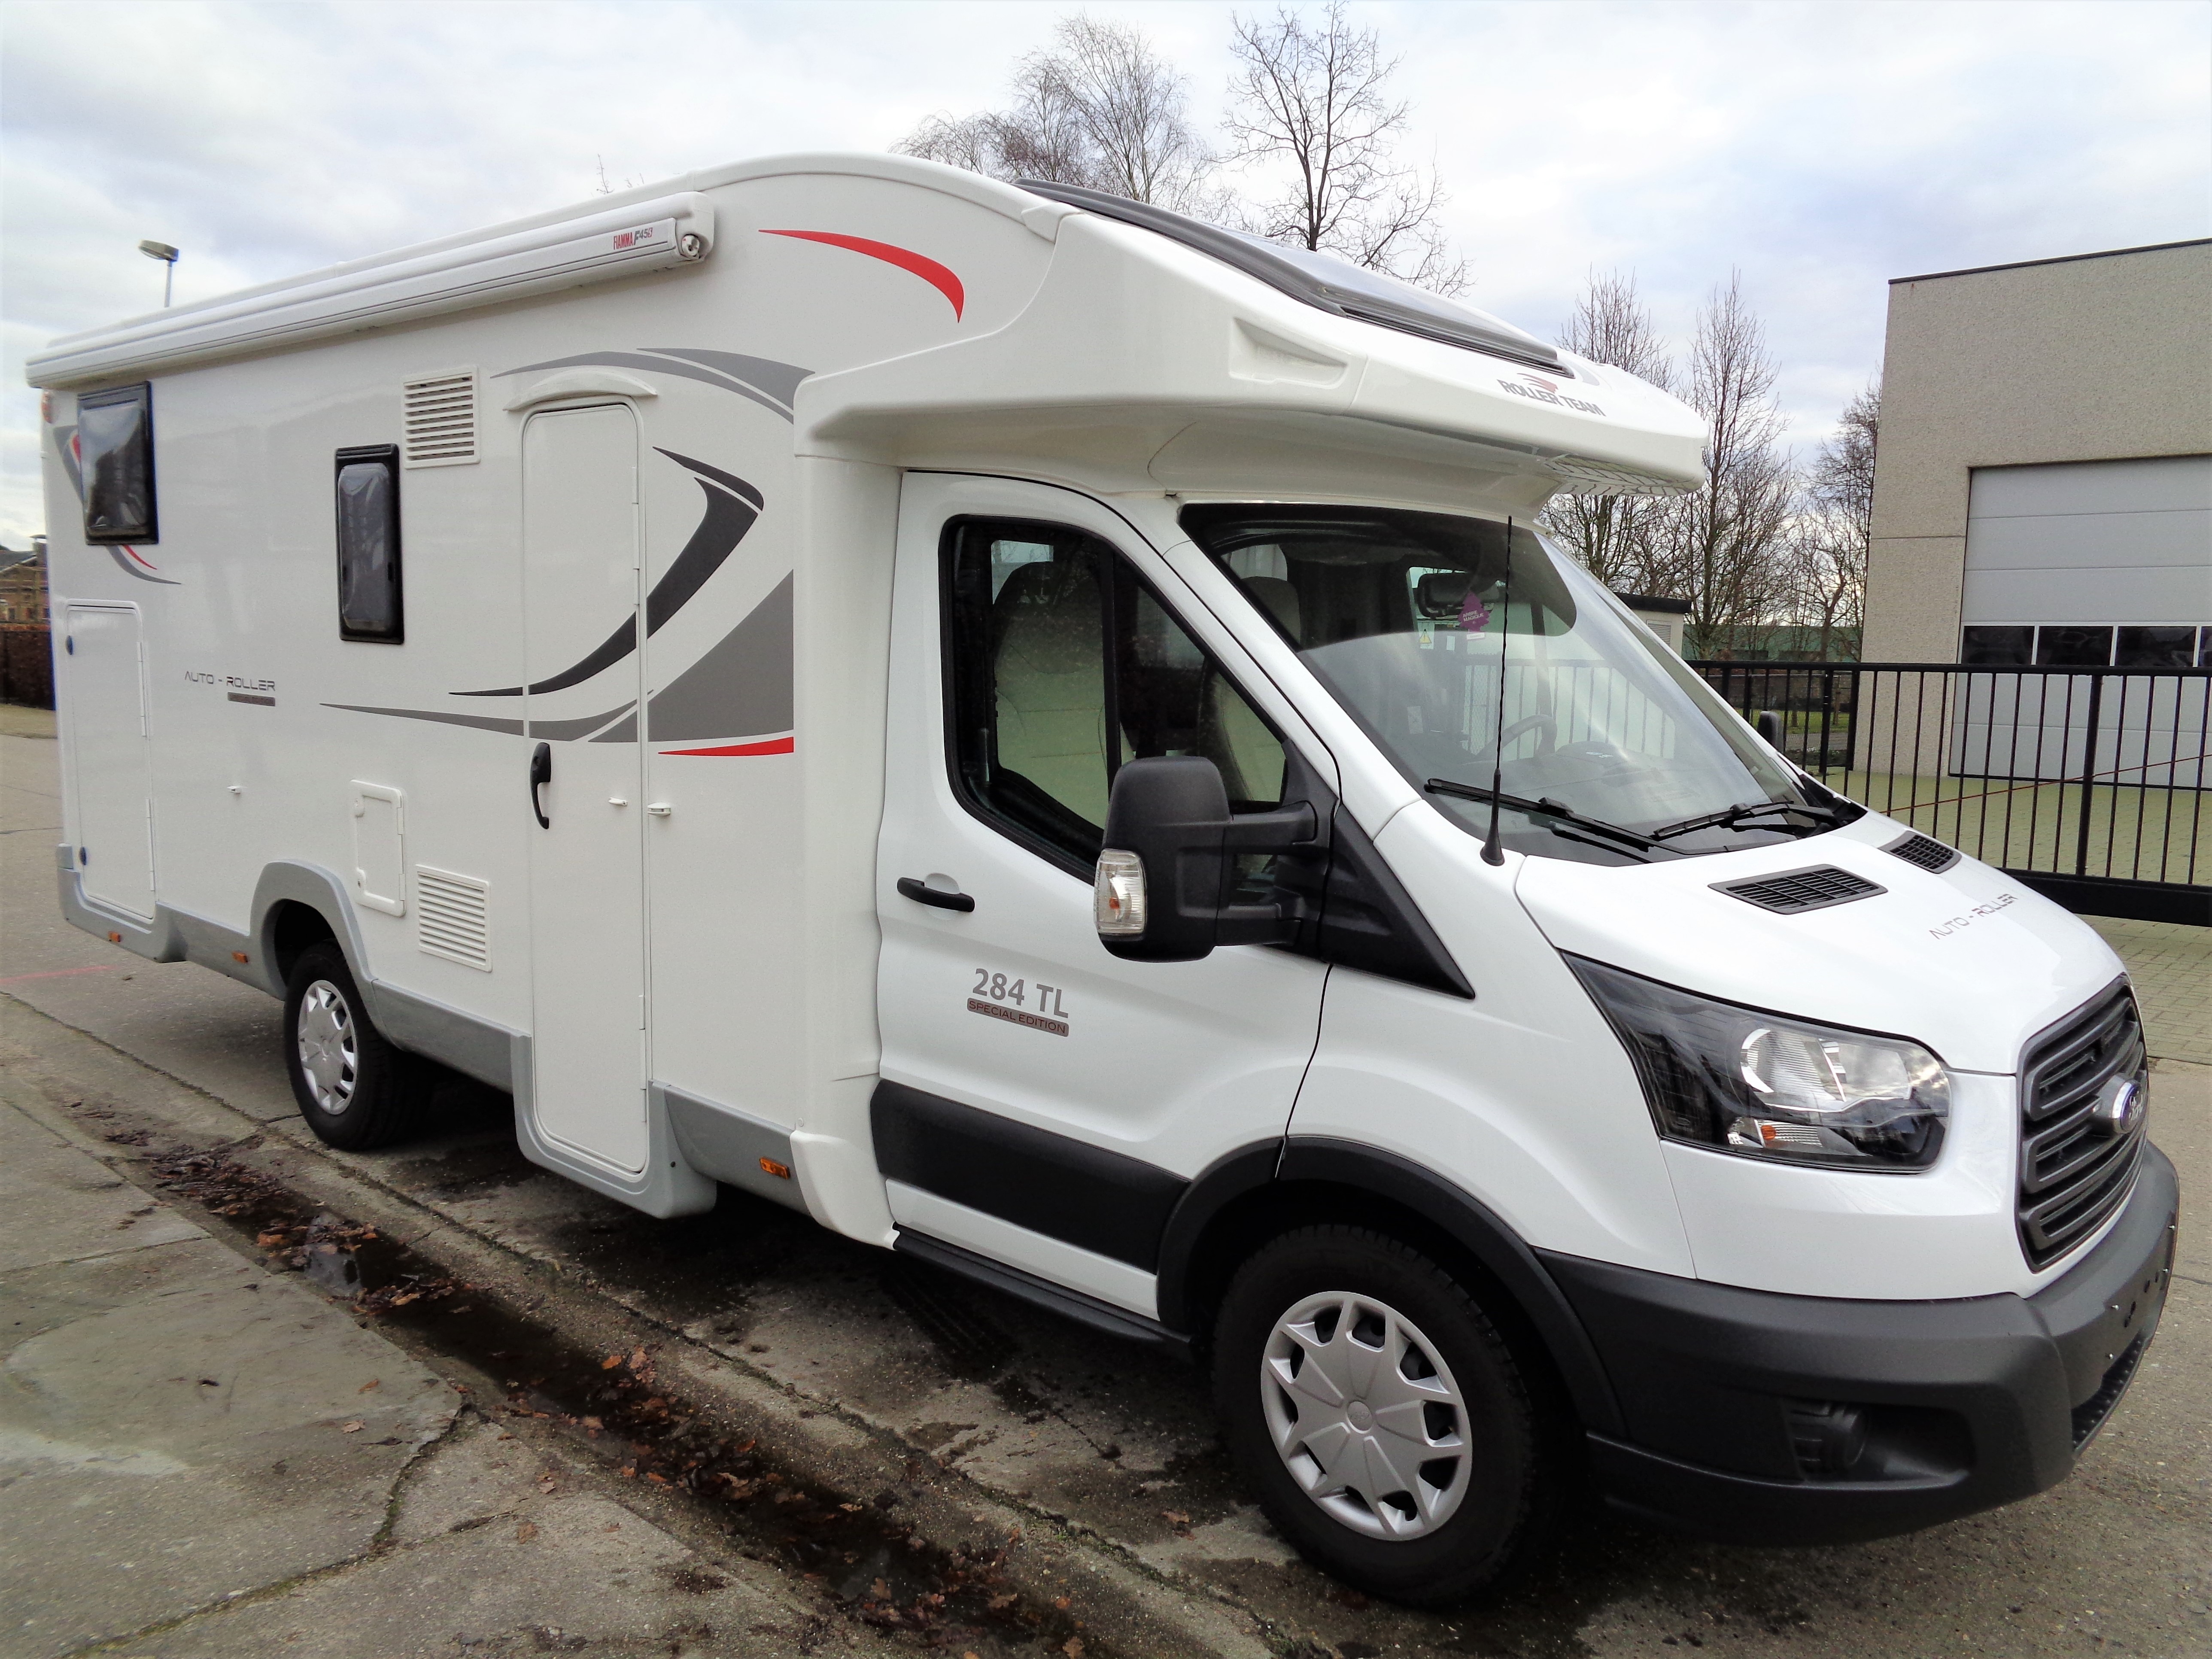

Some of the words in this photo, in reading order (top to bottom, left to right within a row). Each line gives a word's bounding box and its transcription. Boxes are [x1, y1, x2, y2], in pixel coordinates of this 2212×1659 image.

[614, 232, 633, 250] FIAMMA
[1497, 379, 1564, 406] ROLLER
[1559, 395, 1607, 416] TEAM
[1464, 613, 1484, 622] MAGIQUE
[185, 671, 214, 684] AUTO
[226, 676, 276, 691] ROLLER
[1929, 917, 1970, 939] AUTO
[1971, 893, 2019, 917] ROLLER
[972, 968, 1025, 1006] 284
[1036, 983, 1068, 1018] TL
[969, 1001, 1016, 1021] SPECIAL
[1018, 1014, 1065, 1033] EDITION
